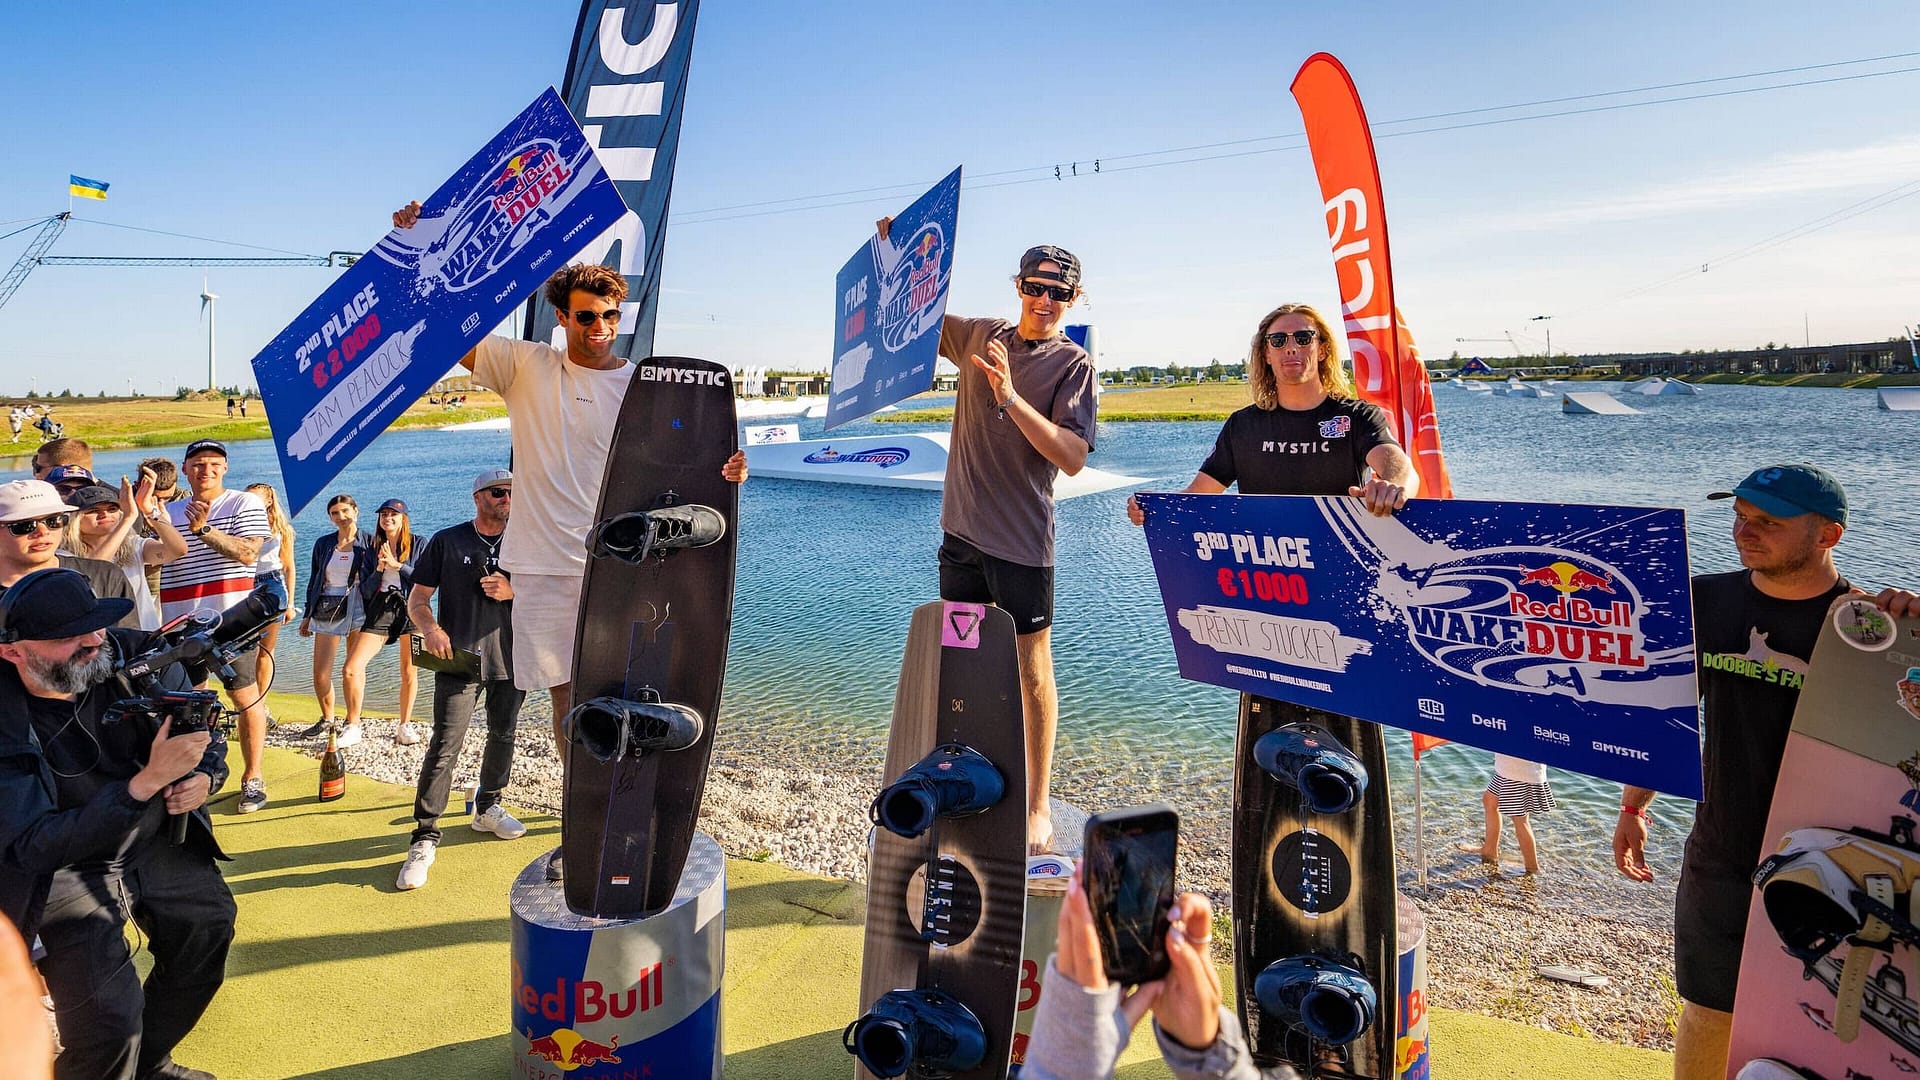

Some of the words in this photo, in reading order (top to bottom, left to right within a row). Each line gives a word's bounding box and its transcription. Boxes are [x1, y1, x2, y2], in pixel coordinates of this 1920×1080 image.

[492, 176, 526, 212] Red
[525, 150, 556, 185] Bull
[568, 214, 594, 238] MYSTIC
[495, 280, 518, 304] Delfi
[321, 281, 380, 348] PLACE
[304, 396, 344, 447] LIAM
[346, 339, 409, 409] PEACOCK
[656, 366, 726, 387] MYSTIC
[1262, 441, 1330, 454] MYSTIC
[1193, 532, 1229, 561] 3RD
[1230, 533, 1315, 569] PLACE
[1509, 592, 1566, 621] Red
[1572, 598, 1631, 628] Bull
[1190, 614, 1250, 647] TRENT
[1260, 621, 1339, 667] STUCKEY
[1702, 652, 1778, 683] DOOBIE'S
[1780, 669, 1805, 689] FA
[1471, 713, 1508, 731] Delfi
[1533, 726, 1571, 743] Balcia
[1602, 743, 1650, 761] MYSTIC
[512, 957, 566, 1023] Red
[574, 961, 664, 1024] Bull
